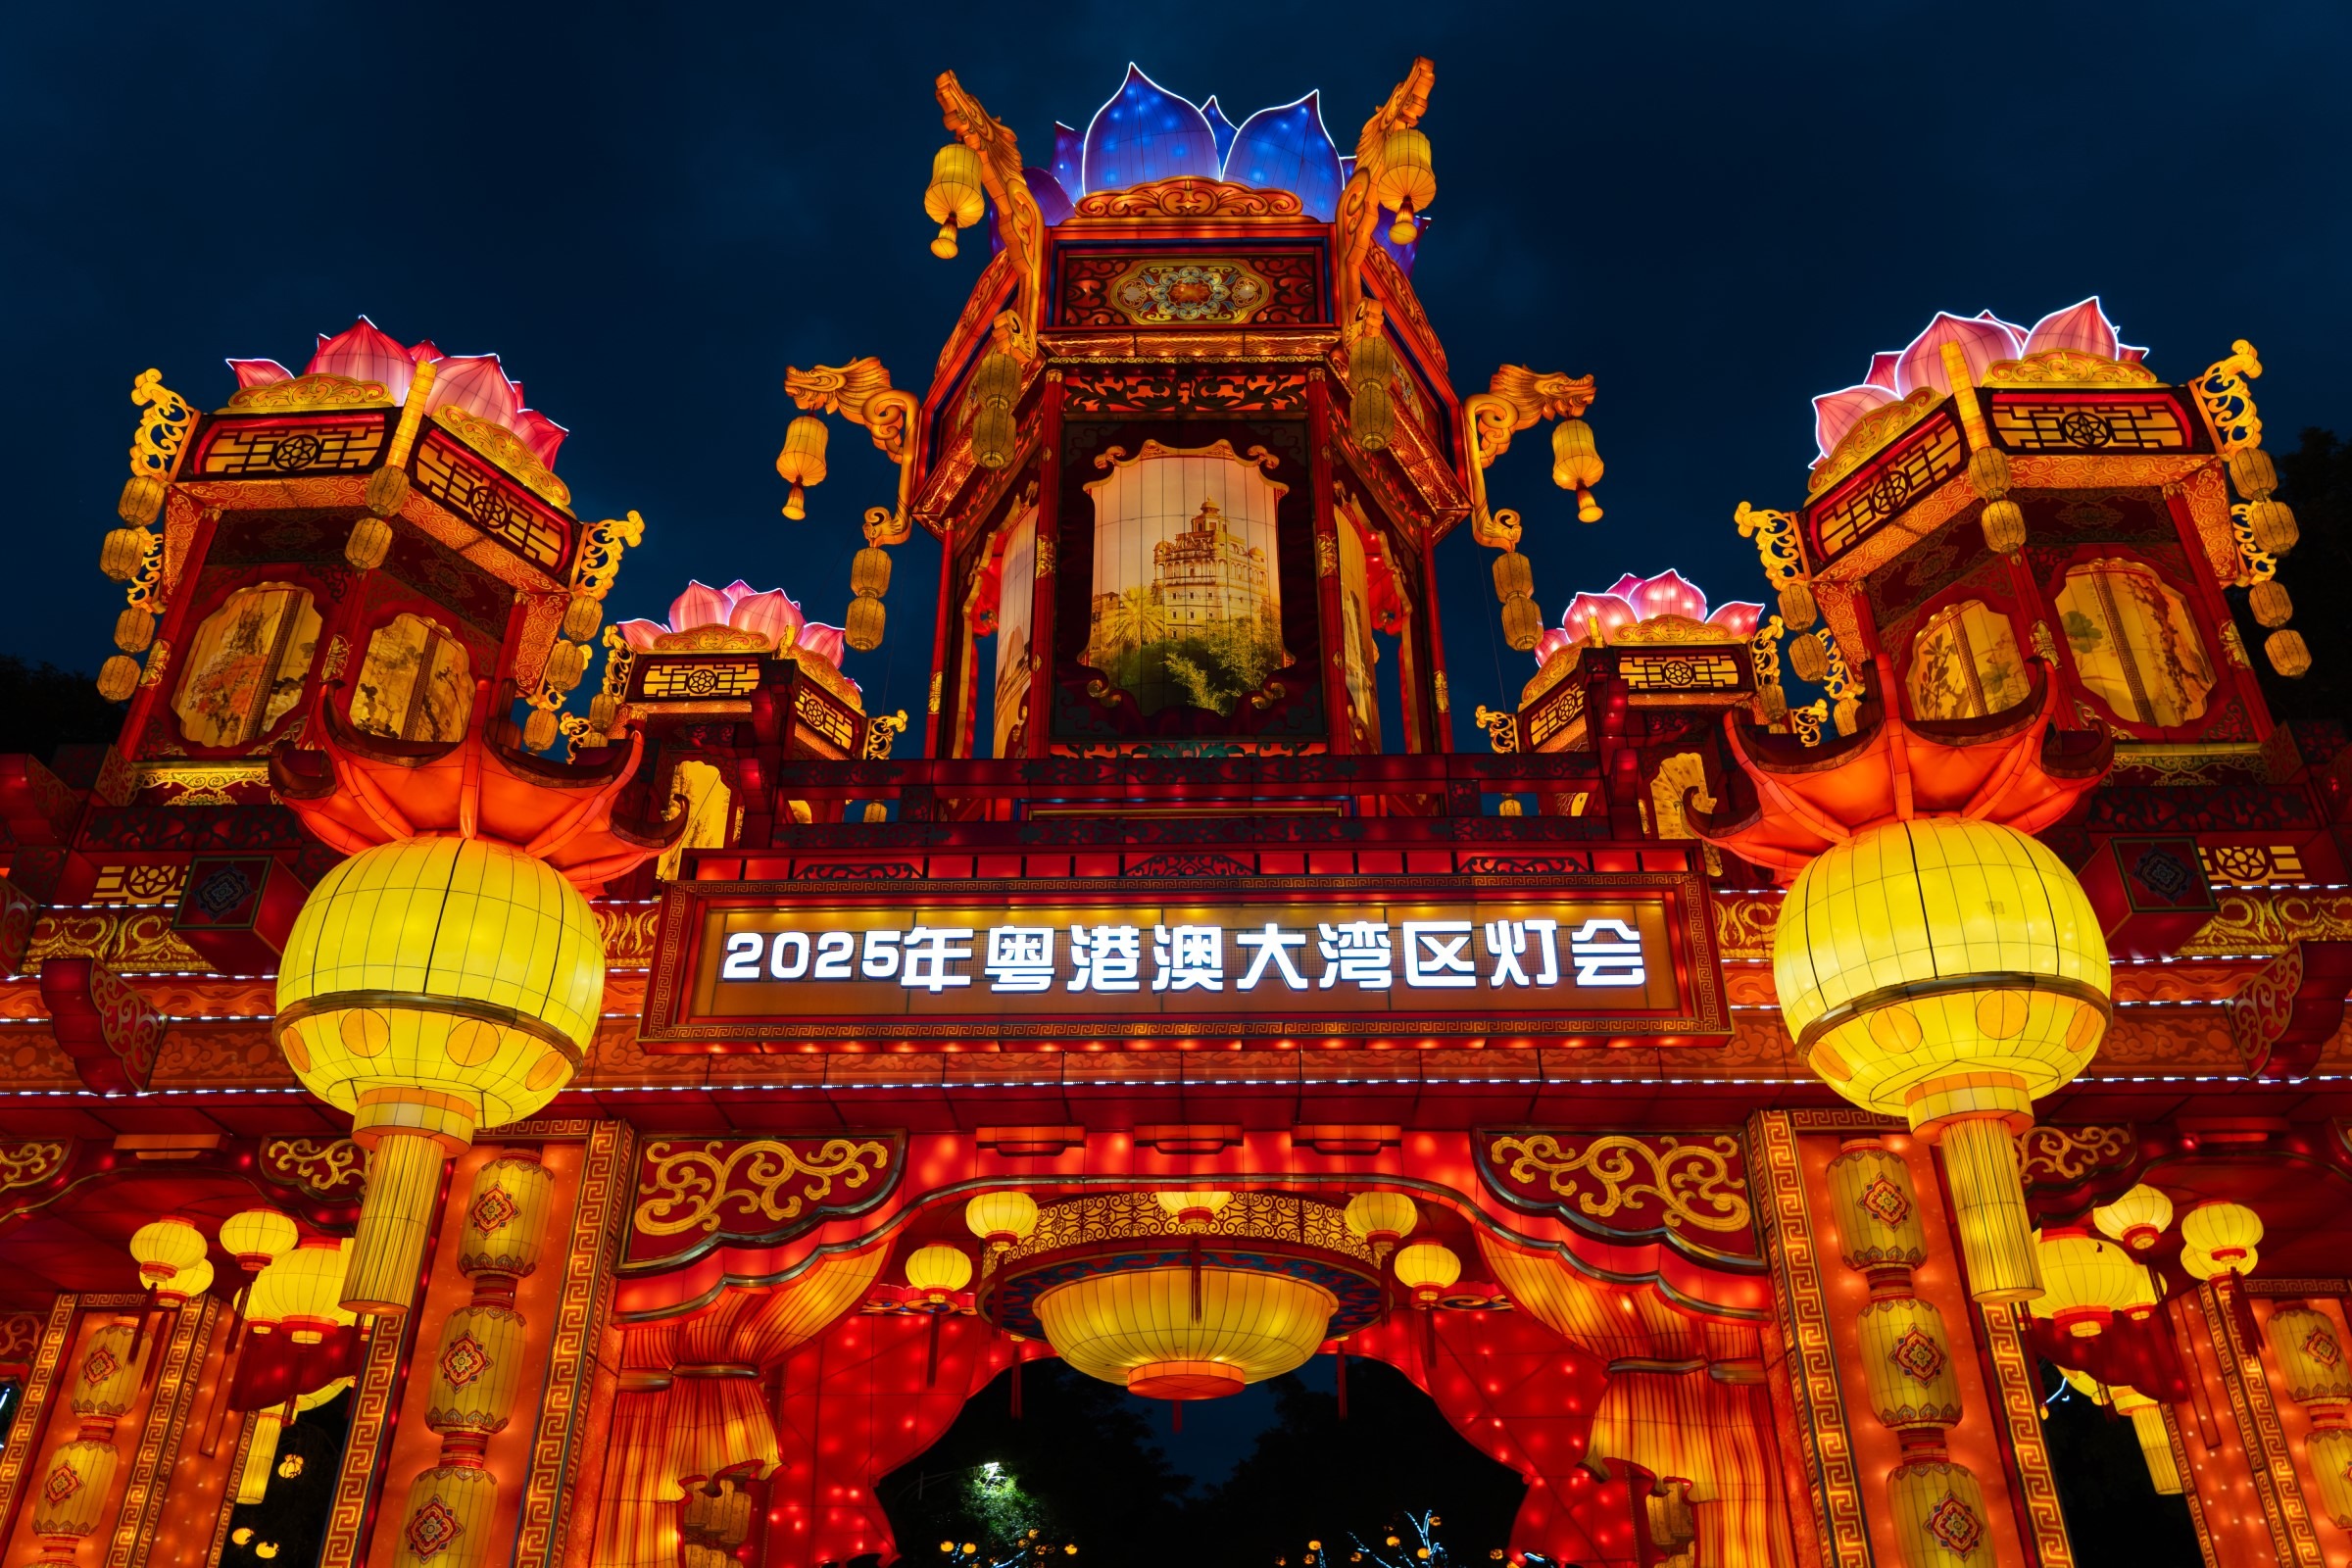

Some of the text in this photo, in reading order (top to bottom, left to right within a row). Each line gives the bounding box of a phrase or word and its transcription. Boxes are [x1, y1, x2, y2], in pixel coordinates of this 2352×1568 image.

[722, 919, 1645, 993] 2025年粤港澳大湾区灯会
